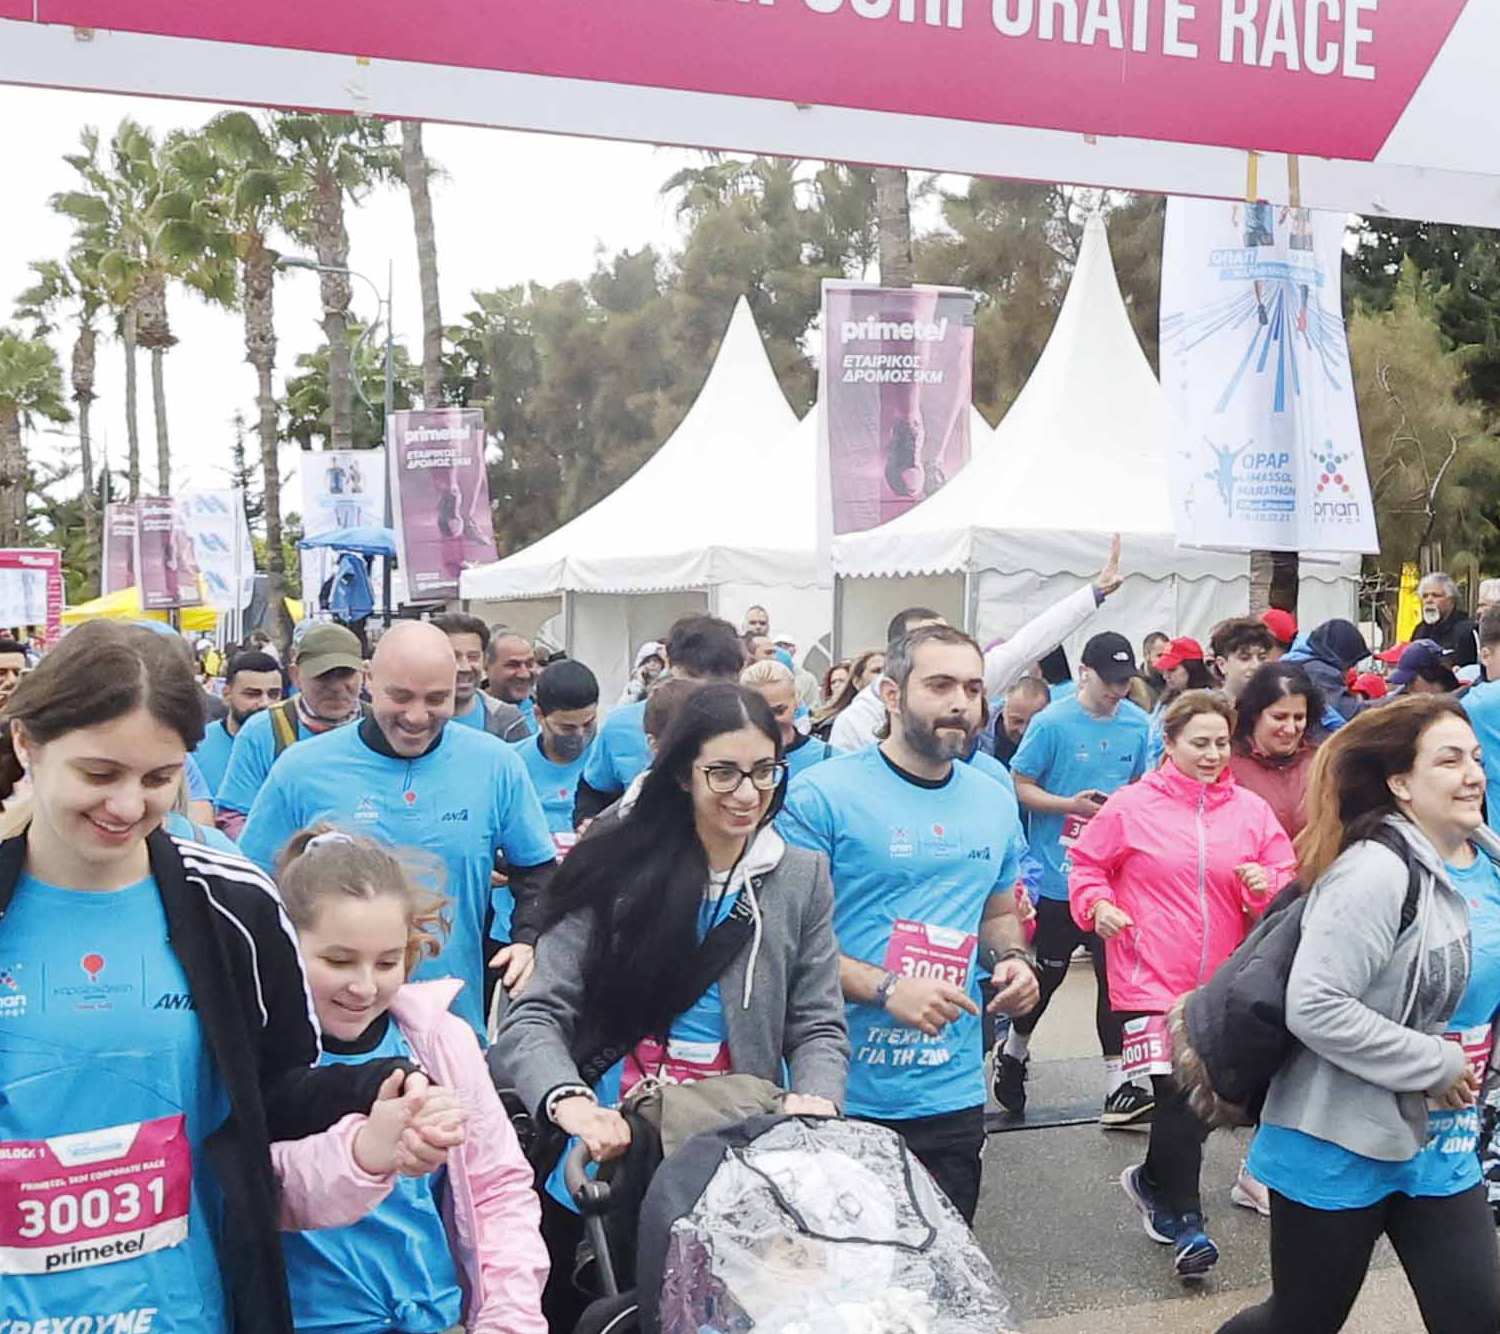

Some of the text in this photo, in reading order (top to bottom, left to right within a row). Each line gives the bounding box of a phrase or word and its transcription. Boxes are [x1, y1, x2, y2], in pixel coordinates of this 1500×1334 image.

[841, 316, 948, 344] primetel
[842, 369, 912, 383] ΔΡΟΜΟΣ
[1242, 452, 1290, 469] OPAP
[17, 1176, 164, 1238] 30031
[45, 1232, 146, 1270] primetel
